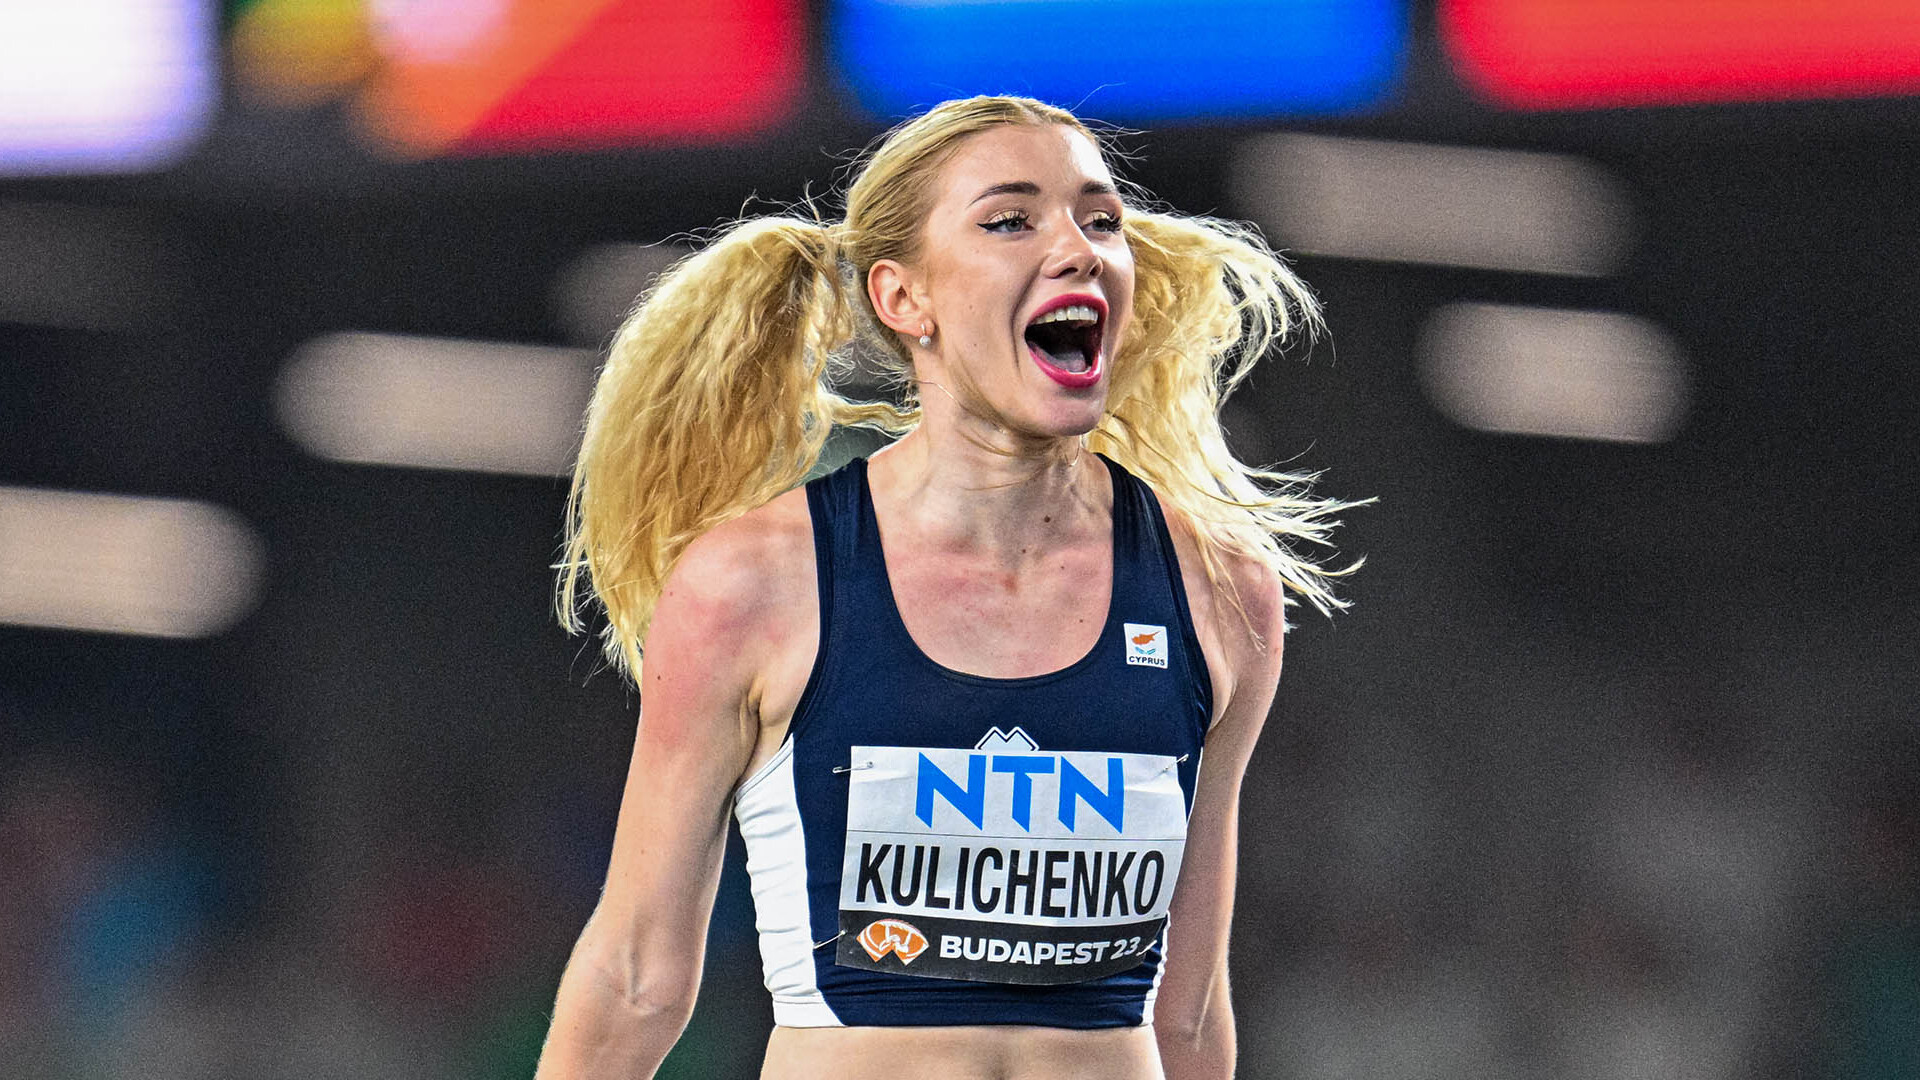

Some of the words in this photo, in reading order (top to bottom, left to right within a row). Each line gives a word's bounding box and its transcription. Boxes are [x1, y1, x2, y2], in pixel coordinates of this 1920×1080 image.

[1128, 655, 1165, 666] CYPRUS
[915, 751, 1124, 834] NTN
[855, 842, 1165, 918] KULICHENKO
[939, 934, 1110, 965] BUDAPEST
[1110, 936, 1141, 960] 23
